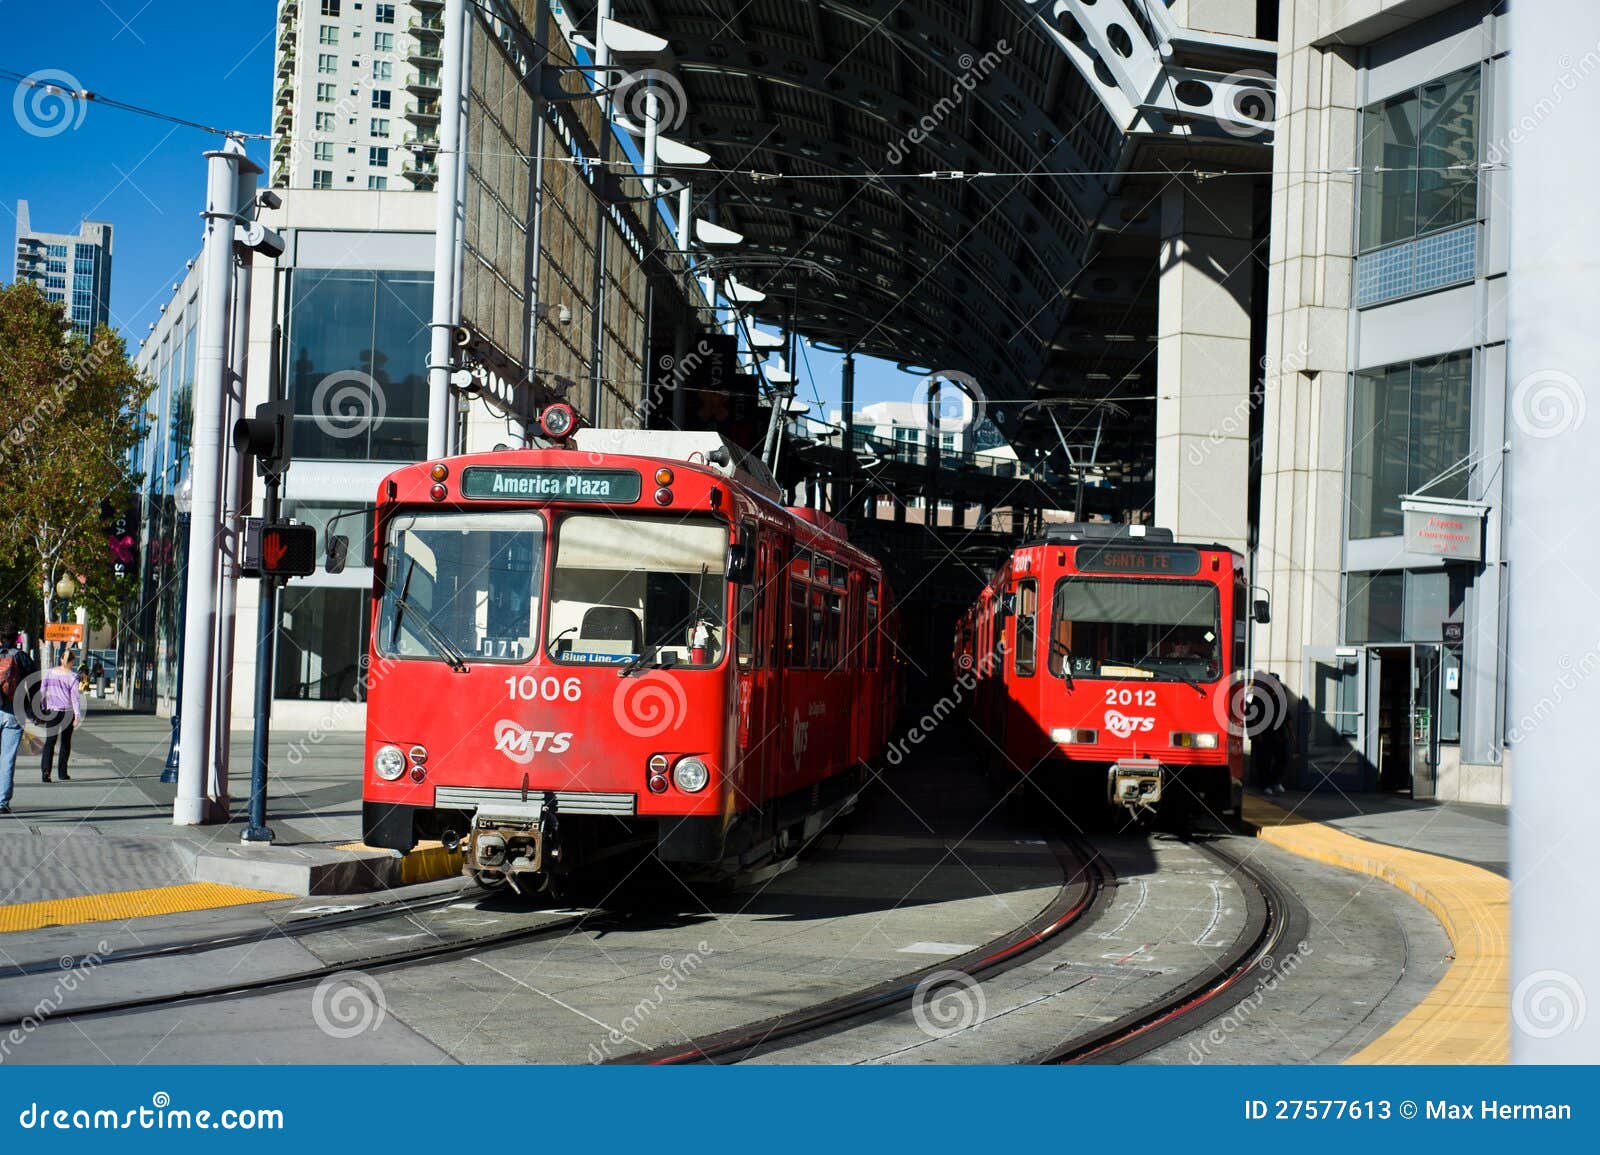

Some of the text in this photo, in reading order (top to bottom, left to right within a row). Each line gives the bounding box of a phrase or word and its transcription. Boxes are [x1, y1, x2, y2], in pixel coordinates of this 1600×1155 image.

[492, 474, 610, 495] America Plaza
[1103, 553, 1170, 568] SANTA FE
[562, 652, 612, 663] Blue Line
[1449, 671, 1456, 682] A
[504, 675, 582, 702] 1006
[1105, 688, 1157, 707] 2012
[1104, 715, 1156, 732] MTS
[494, 729, 574, 754] MTS
